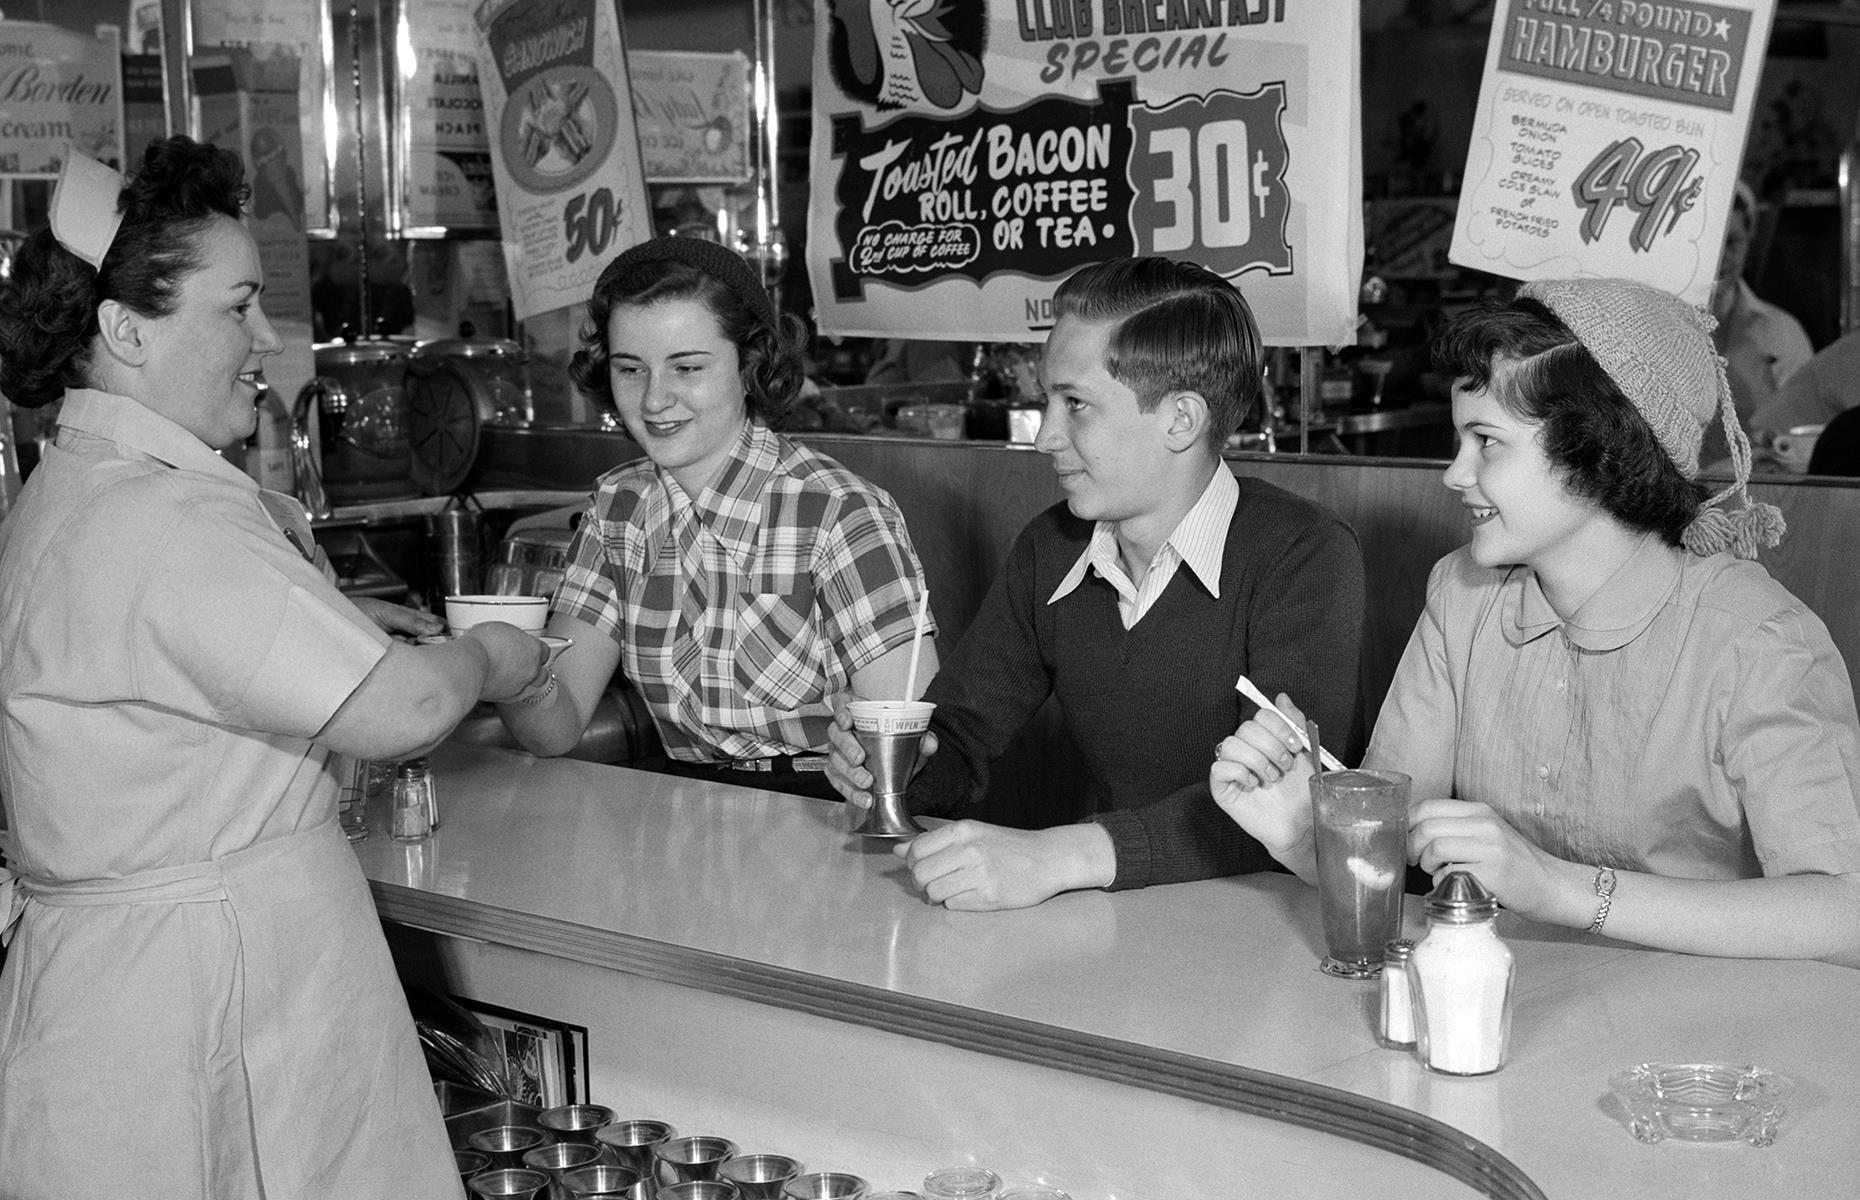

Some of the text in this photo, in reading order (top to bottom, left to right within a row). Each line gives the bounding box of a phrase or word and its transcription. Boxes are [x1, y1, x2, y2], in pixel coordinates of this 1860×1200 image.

[1615, 1, 1713, 37] POUND
[1040, 32, 1230, 84] SPECIAL
[1509, 17, 1732, 98] HAMBURGER
[3, 63, 113, 105] Borden
[1502, 87, 1705, 138] SERVED ON OPEN TOASTED BUN
[1511, 114, 1568, 134] BERMUDA
[1518, 127, 1557, 143] ONION
[1510, 141, 1562, 160] TOMATO
[1512, 154, 1555, 170] SLICES
[859, 123, 1112, 224] Toasted BACON
[1511, 170, 1557, 186] CREAMY
[1498, 178, 1561, 199] COLE SLAW
[918, 178, 1108, 222] ROLL, COFFEE
[993, 217, 1025, 250] OR
[1495, 218, 1551, 239] POTATOES
[1530, 215, 1560, 230] FRIED
[862, 229, 963, 248] NO CHARGE FOR
[860, 243, 971, 267] 2nd CUP OF COFFEE
